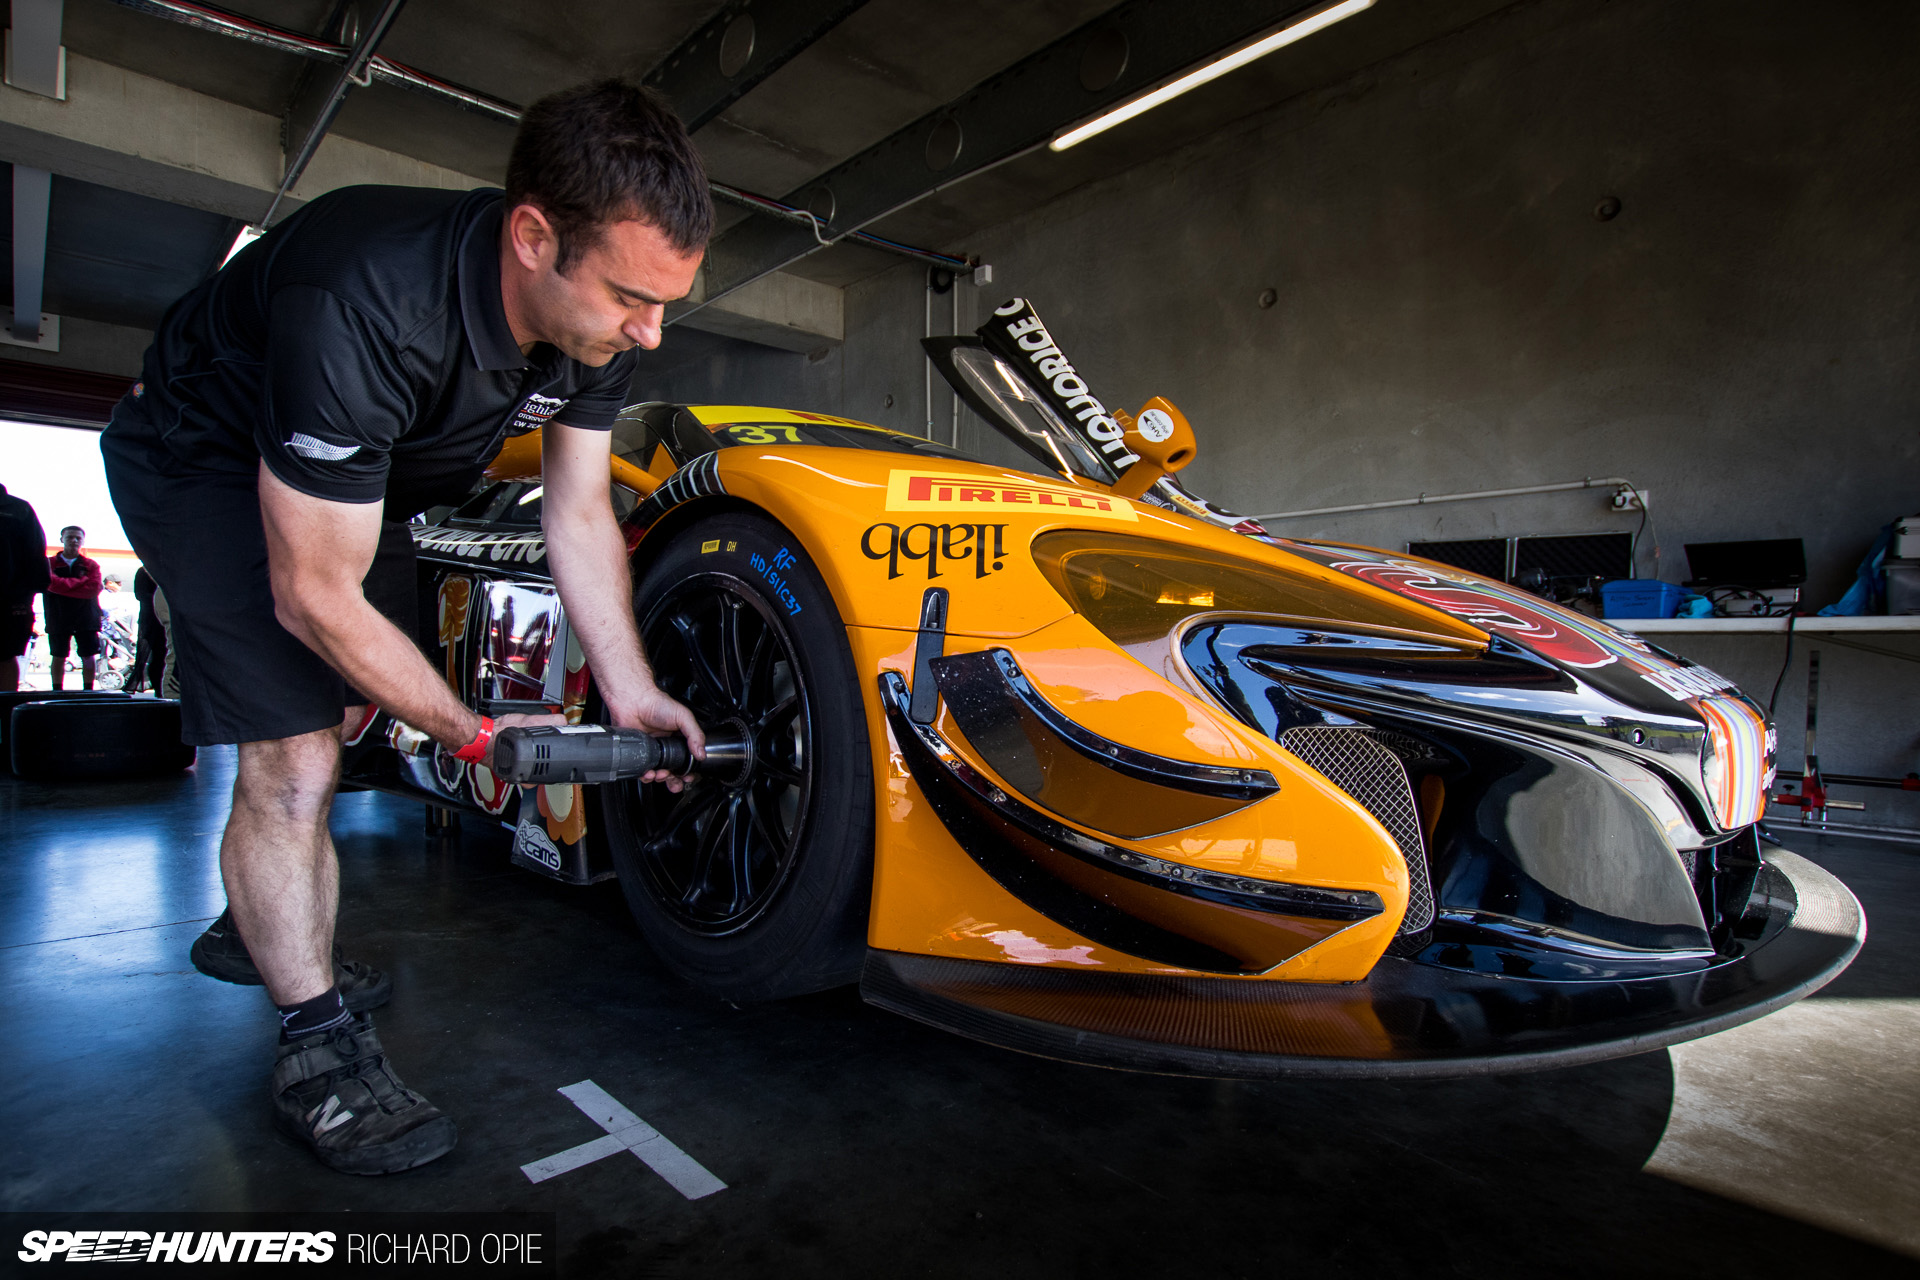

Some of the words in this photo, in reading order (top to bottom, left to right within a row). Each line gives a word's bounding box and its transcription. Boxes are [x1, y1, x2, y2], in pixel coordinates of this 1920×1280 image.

[1006, 315, 1141, 470] LIQUORICE
[523, 401, 558, 416] ighla
[728, 425, 802, 444] 37
[908, 476, 1112, 512] PIRELLI
[490, 531, 547, 564] CHO
[726, 541, 737, 552] DH
[773, 547, 797, 570] RF
[861, 523, 1009, 580] ilabb
[525, 841, 560, 869] cams
